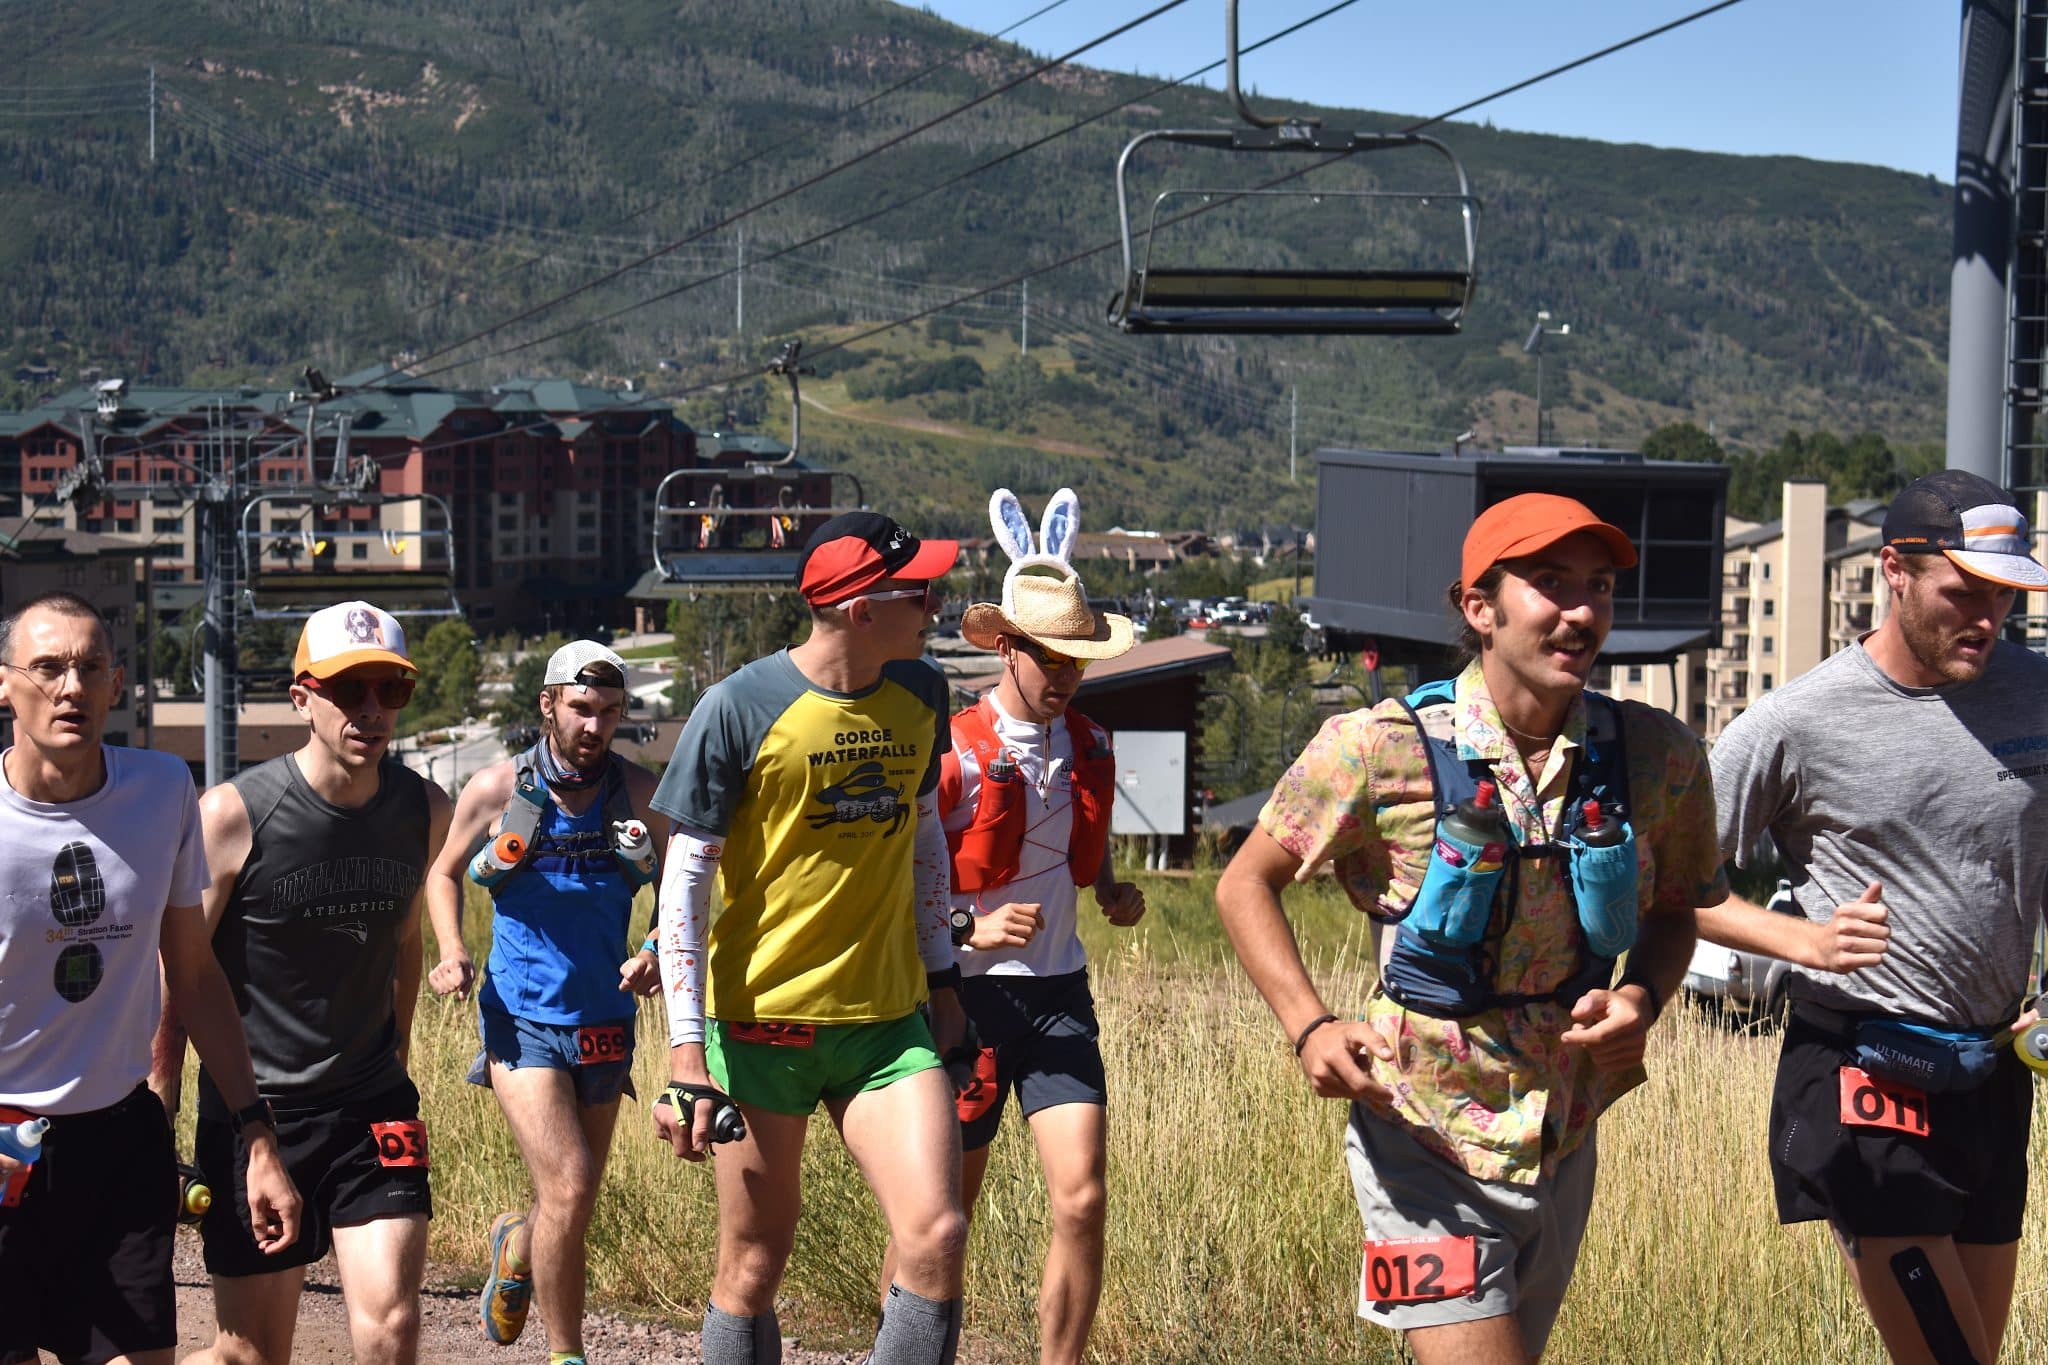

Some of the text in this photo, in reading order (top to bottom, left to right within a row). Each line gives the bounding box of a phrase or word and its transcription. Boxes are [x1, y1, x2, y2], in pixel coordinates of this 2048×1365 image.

[834, 729, 892, 745] GORGE
[808, 744, 916, 766] WATERFALLS
[270, 857, 369, 914] PORTLAND
[304, 900, 394, 918] ATHLETICS
[580, 1032, 625, 1057] 069
[1875, 1043, 1935, 1073] ULTIMATE
[1852, 1085, 1926, 1131] 011
[1371, 1253, 1446, 1298] 012
[1908, 1267, 1921, 1280] KT
